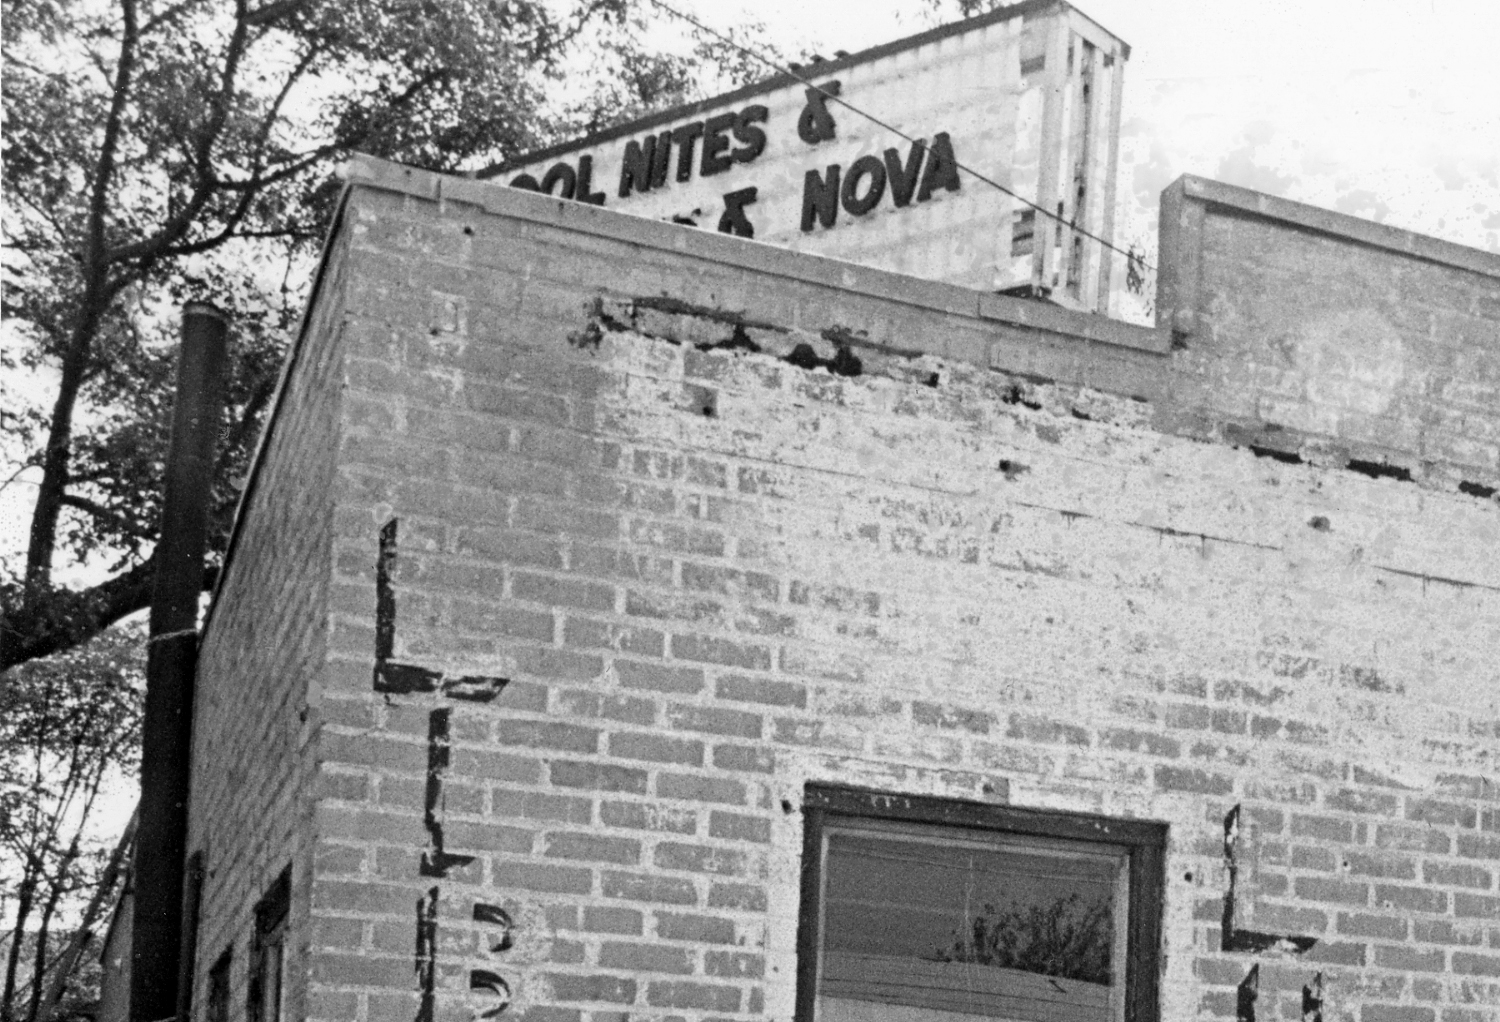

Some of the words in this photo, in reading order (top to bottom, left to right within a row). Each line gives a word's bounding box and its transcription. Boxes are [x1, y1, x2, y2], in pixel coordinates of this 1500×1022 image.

[618, 105, 768, 198] NITES
[798, 80, 841, 144] &
[800, 132, 961, 232] NOVA
